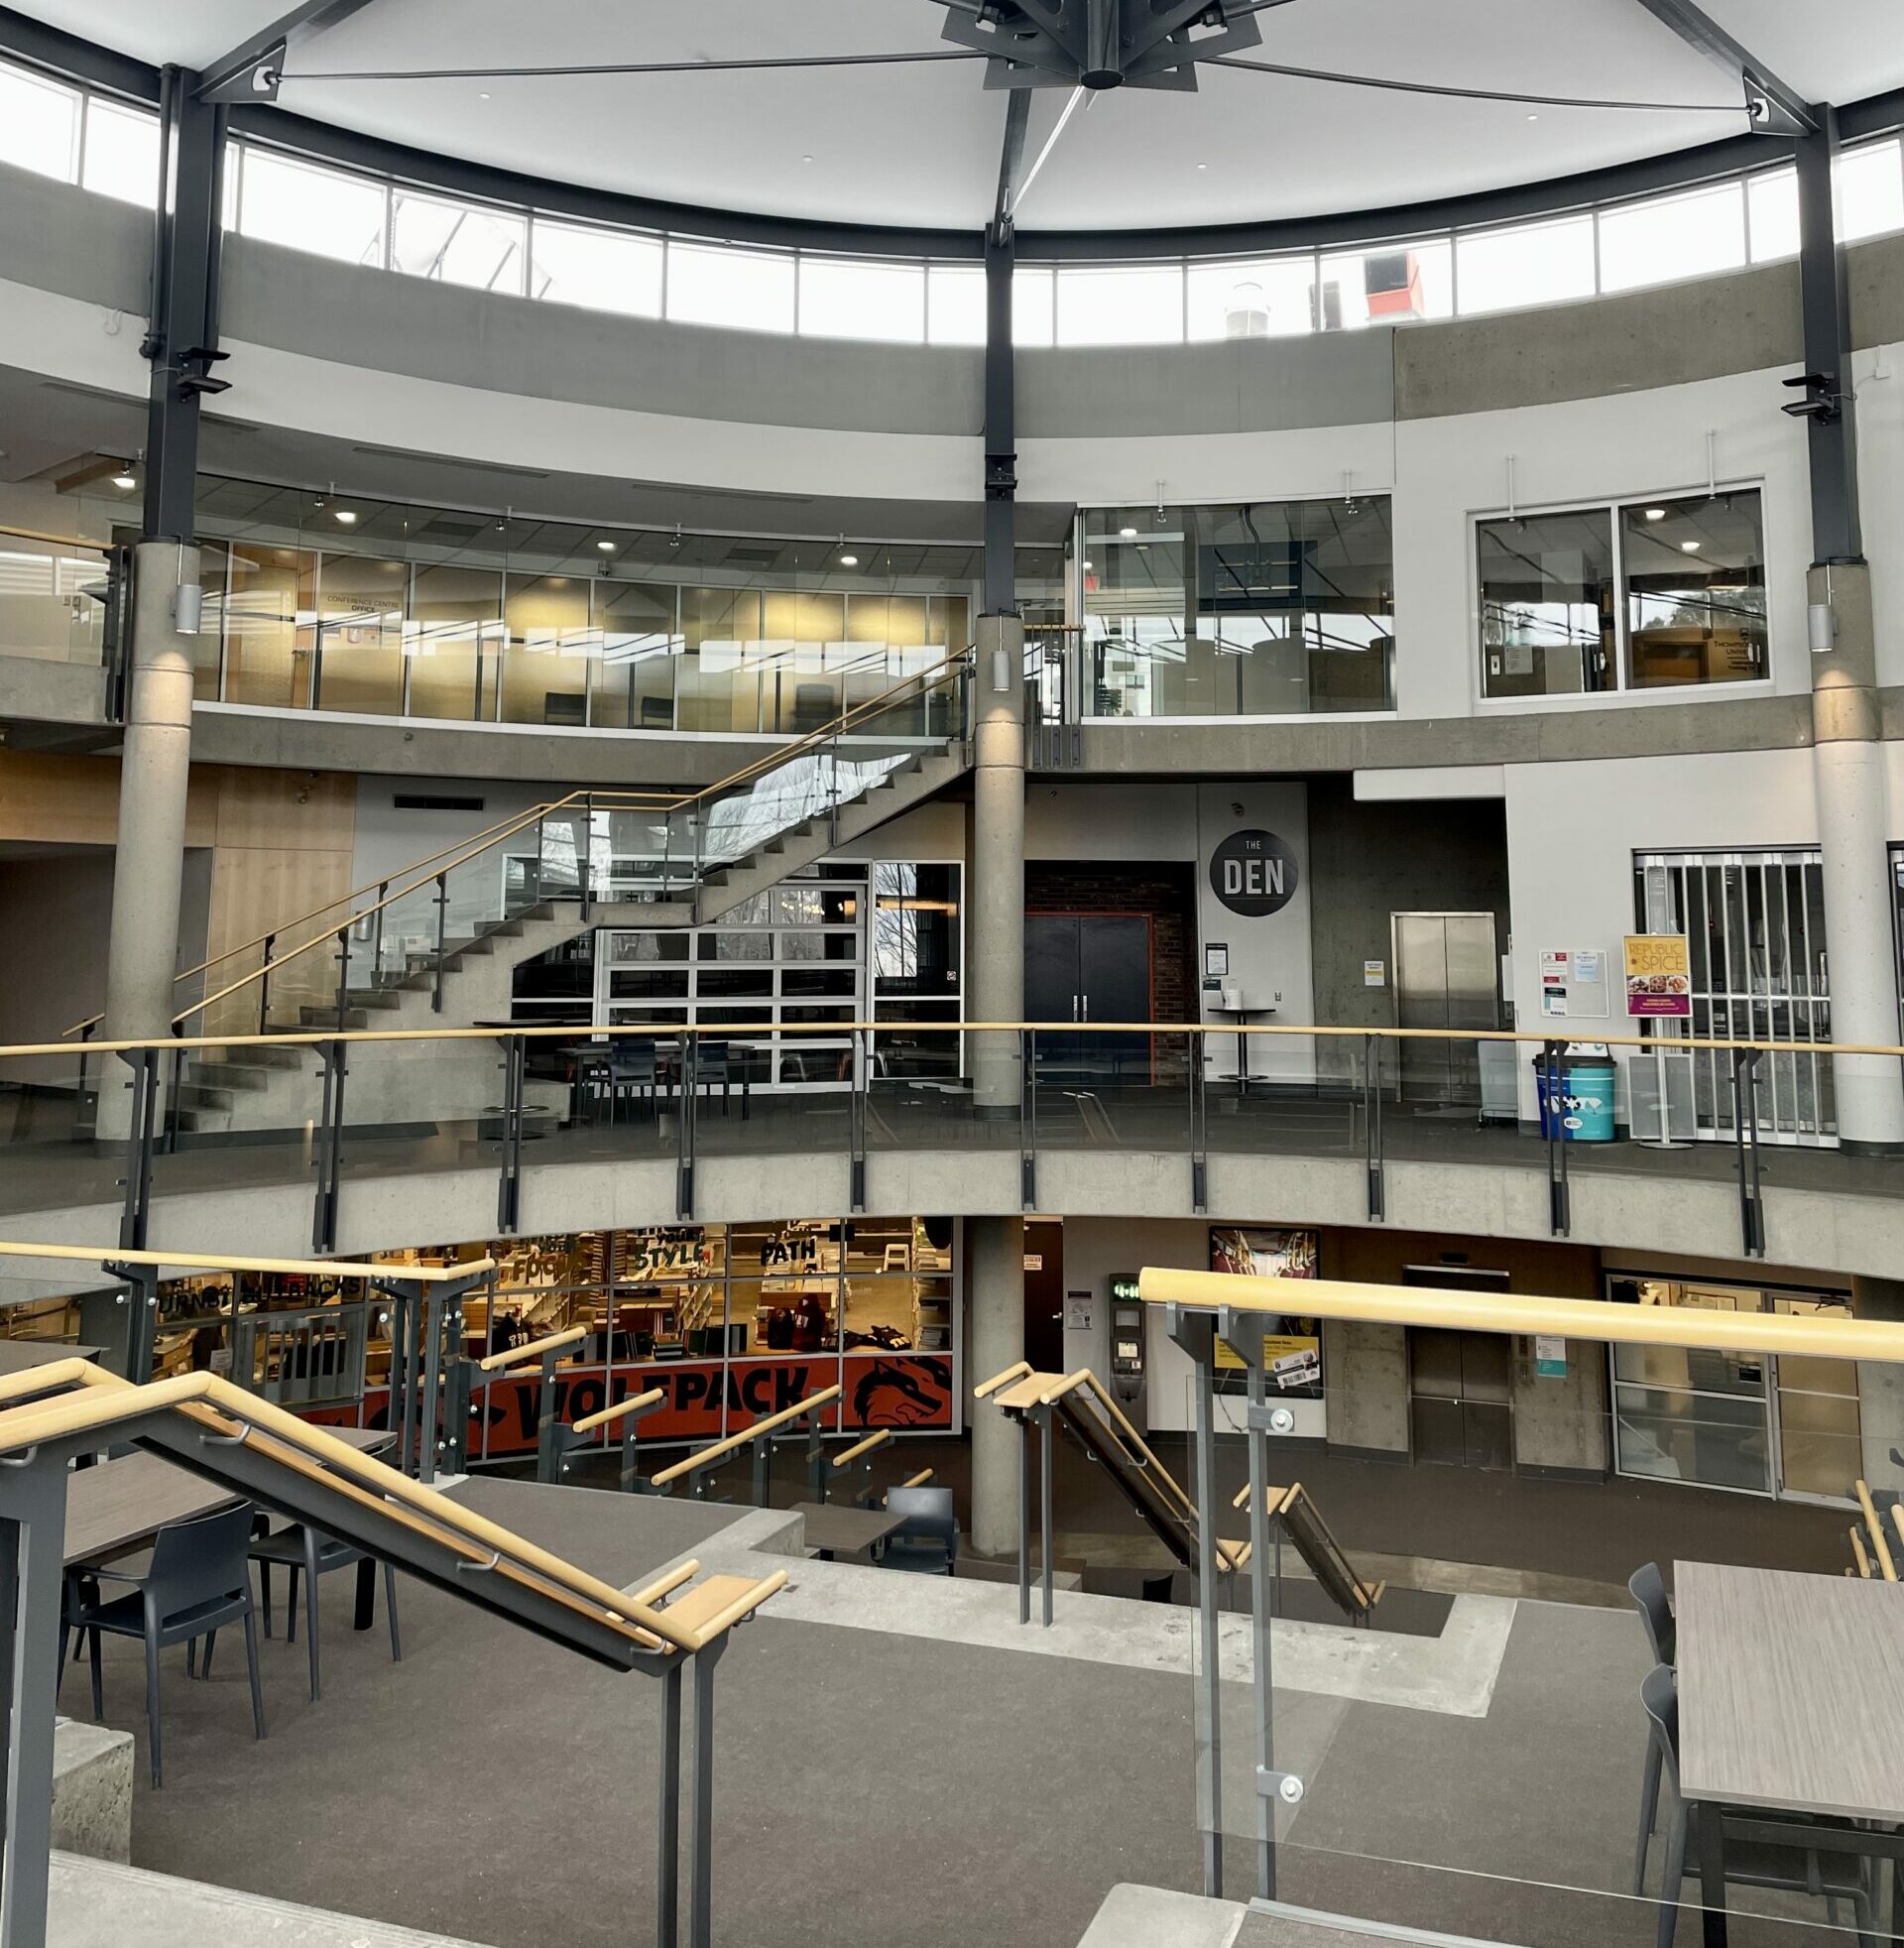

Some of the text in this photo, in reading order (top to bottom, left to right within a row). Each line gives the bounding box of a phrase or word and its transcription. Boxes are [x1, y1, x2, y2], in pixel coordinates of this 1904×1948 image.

[327, 595, 399, 609] CONFERENCE CENTRE
[1246, 840, 1261, 850] THE
[1224, 859, 1284, 895] DEN
[1628, 943, 1683, 955] REPUBLIC
[1641, 955, 1685, 971] SPICE
[635, 1244, 706, 1271] STYLE
[761, 1238, 816, 1267] PATH
[515, 1368, 809, 1440] WOLFPACK
